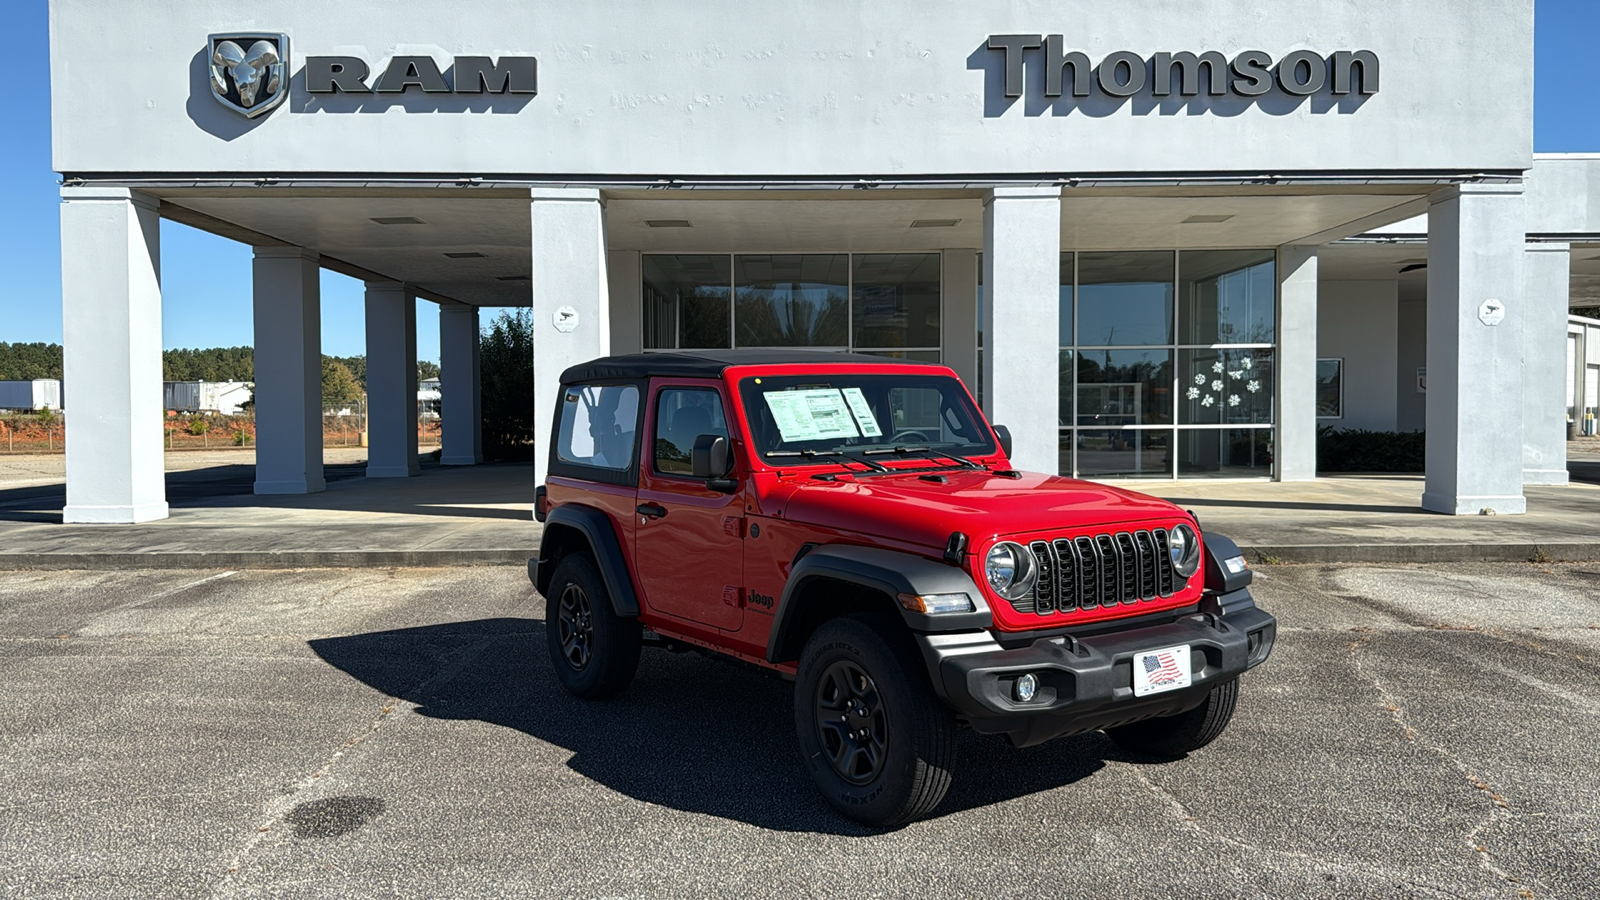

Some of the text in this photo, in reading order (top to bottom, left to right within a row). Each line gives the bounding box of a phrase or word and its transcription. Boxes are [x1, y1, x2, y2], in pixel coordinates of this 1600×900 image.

[306, 56, 538, 94] RAM
[987, 34, 1379, 97] Thomson
[747, 589, 774, 610] Jeep
